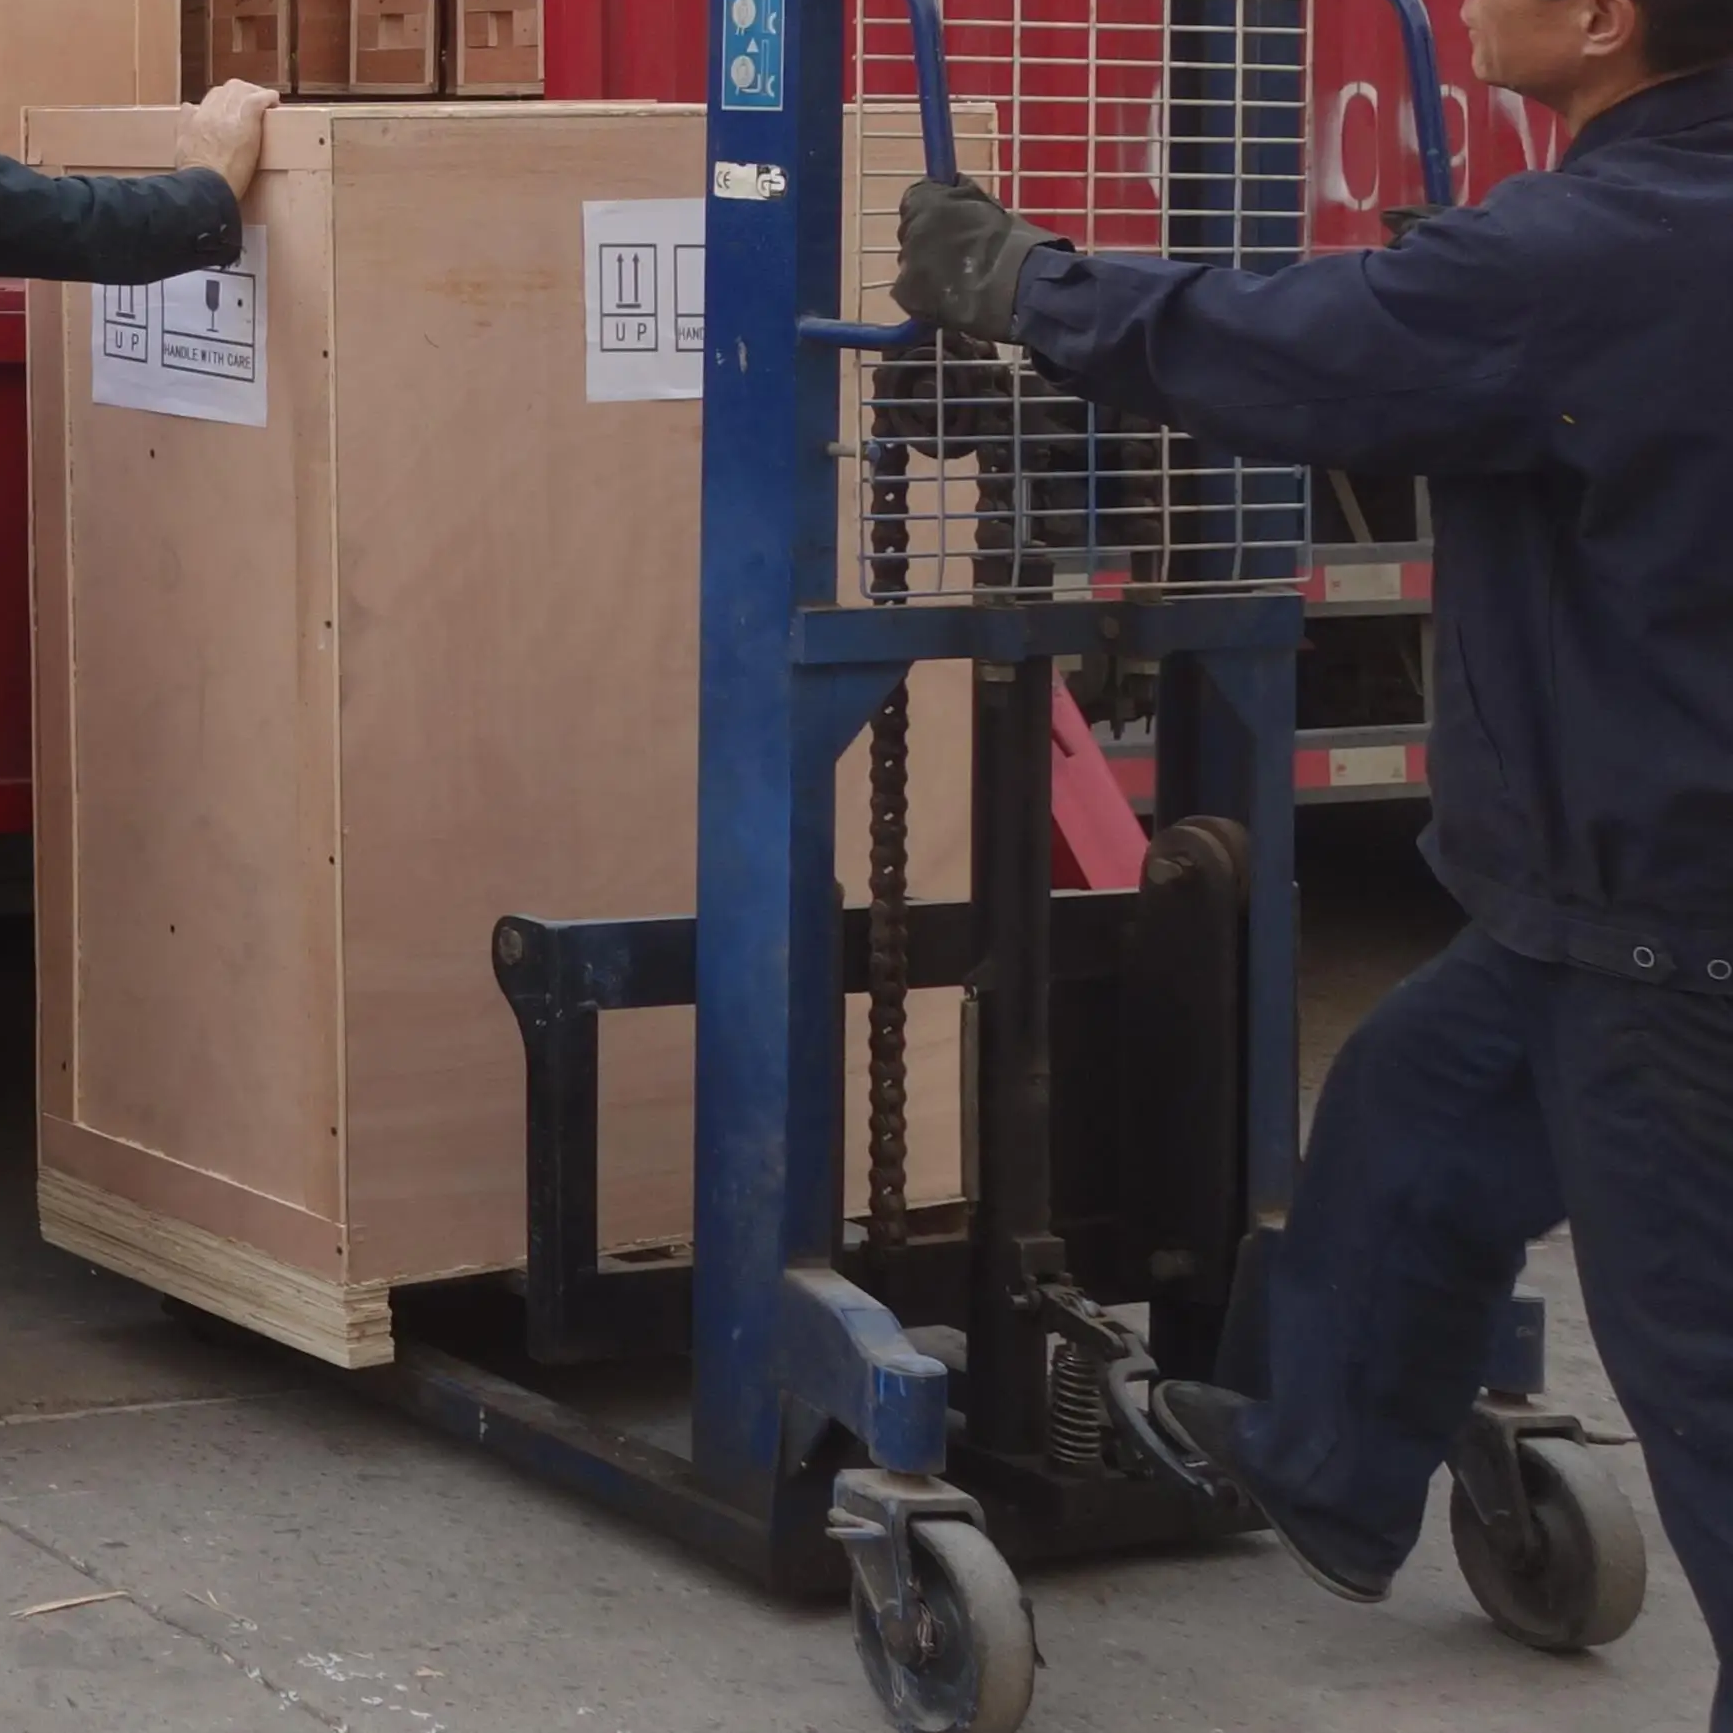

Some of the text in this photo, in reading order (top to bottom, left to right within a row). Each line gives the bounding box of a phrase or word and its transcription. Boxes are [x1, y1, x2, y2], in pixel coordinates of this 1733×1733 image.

[715, 170, 732, 190] CE
[163, 342, 252, 370] HANDLE WITH CARE
